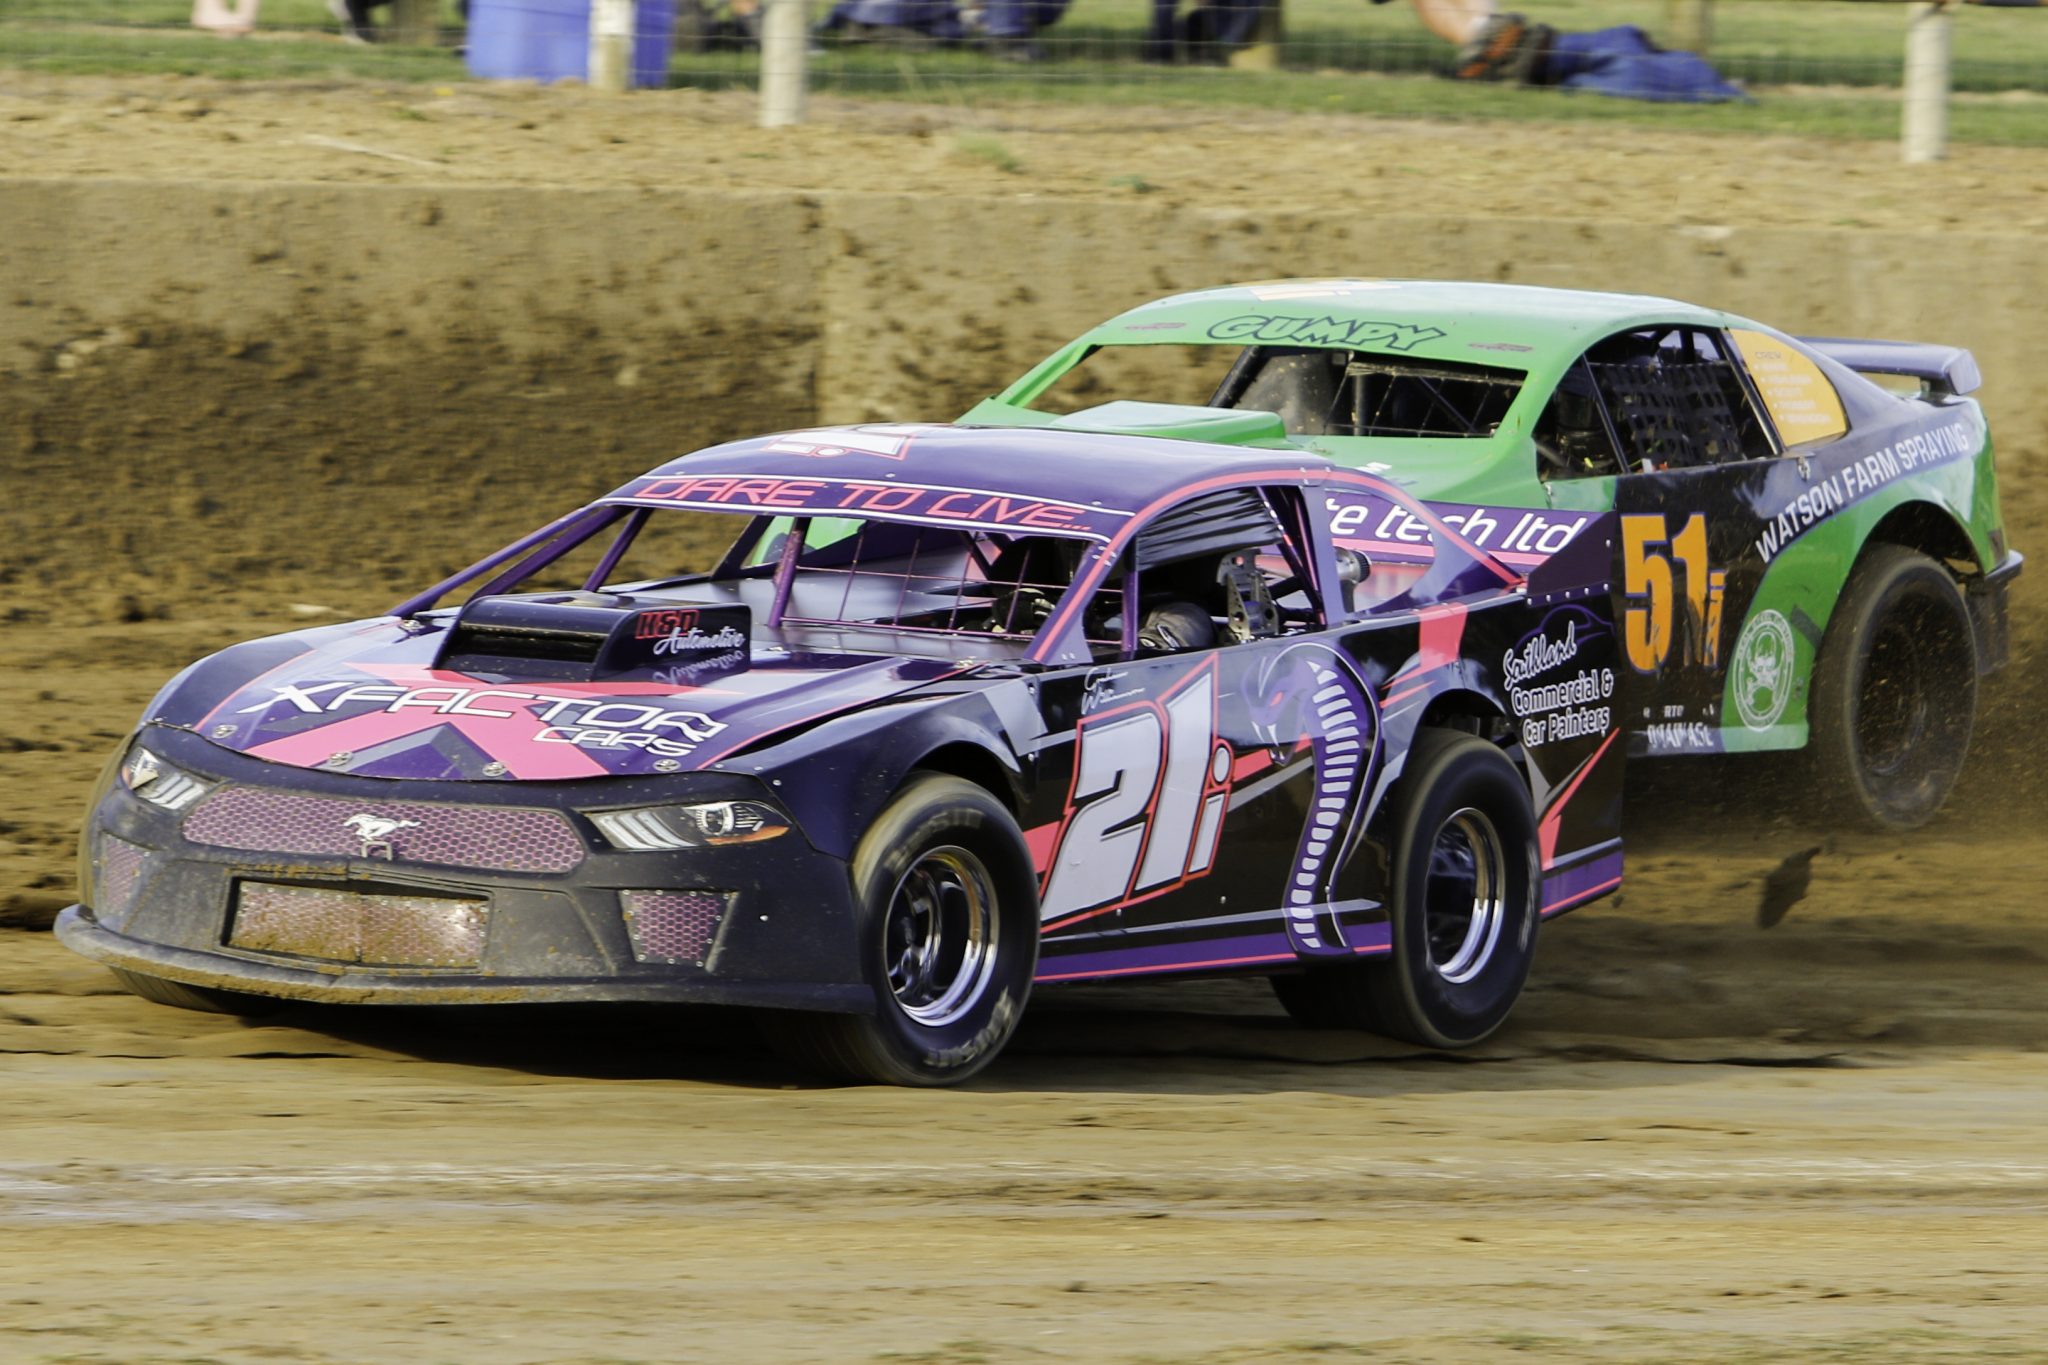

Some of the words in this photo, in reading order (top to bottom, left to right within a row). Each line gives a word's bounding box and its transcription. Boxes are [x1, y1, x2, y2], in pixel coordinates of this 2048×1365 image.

[1207, 315, 1447, 351] GUMPY
[634, 478, 826, 505] DARE
[840, 484, 927, 514] TO
[1755, 475, 1844, 564] WATSON
[1841, 447, 1901, 500] FARM
[1895, 422, 1970, 470] SPRAYING
[1500, 512, 1588, 552] ltd
[653, 625, 746, 656] Automotive
[1511, 669, 1600, 717] Commercial
[1601, 668, 1614, 698] &
[532, 726, 698, 757] CARS
[1523, 718, 1547, 748] Car
[1548, 706, 1610, 742] Painters
